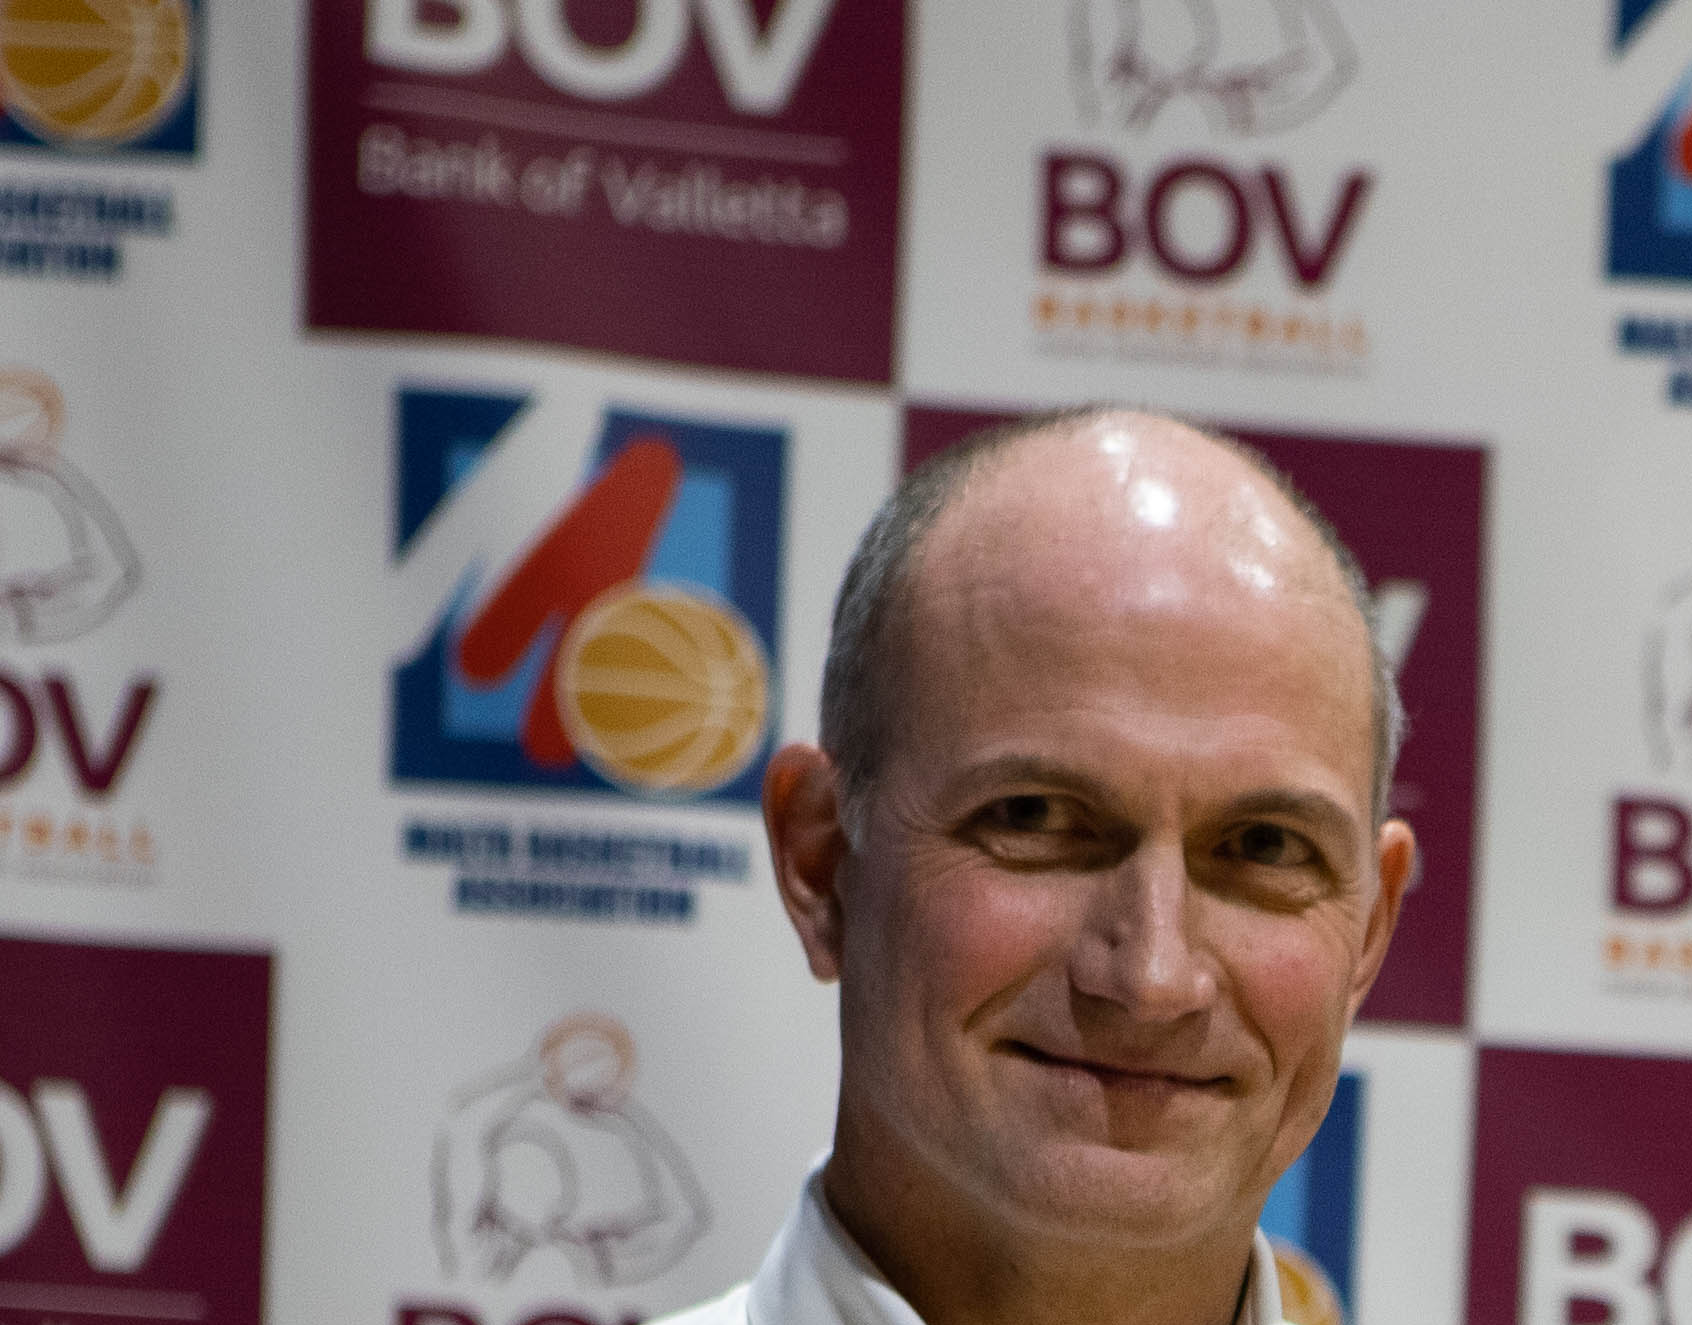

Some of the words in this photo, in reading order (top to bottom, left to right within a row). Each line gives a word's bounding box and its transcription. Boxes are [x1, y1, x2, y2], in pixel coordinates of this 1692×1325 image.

[359, 129, 503, 198] Bank
[522, 142, 588, 215] of
[605, 164, 848, 248] Valletta
[1041, 148, 1373, 289] BOV
